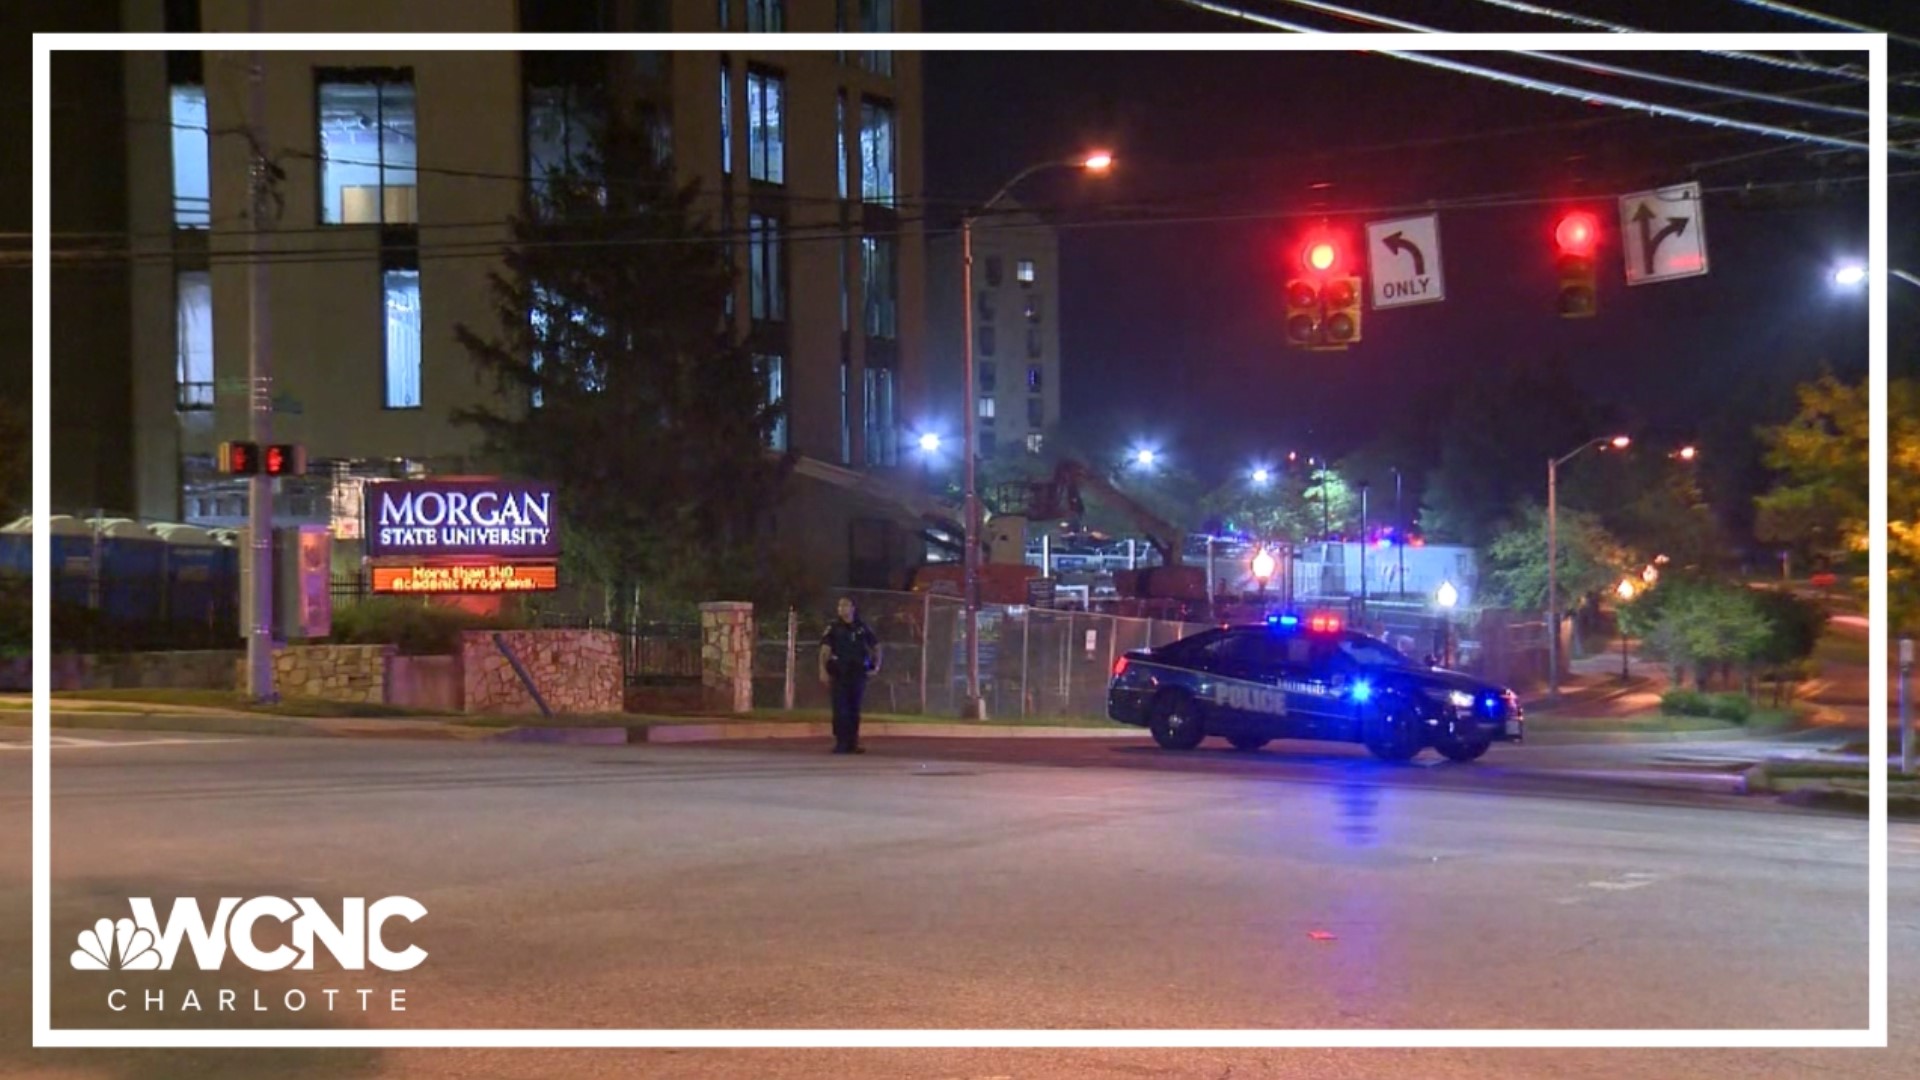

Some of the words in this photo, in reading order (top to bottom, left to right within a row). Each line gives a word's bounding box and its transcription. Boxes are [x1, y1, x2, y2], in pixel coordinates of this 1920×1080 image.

[1383, 277, 1429, 299] ONLY
[379, 491, 551, 526] MORGAN
[380, 527, 437, 545] STATE
[442, 527, 551, 546] UNIVERSITY
[412, 566, 449, 579] More
[452, 566, 486, 579] than
[392, 578, 460, 591] Academic
[1214, 682, 1288, 716] POLICE
